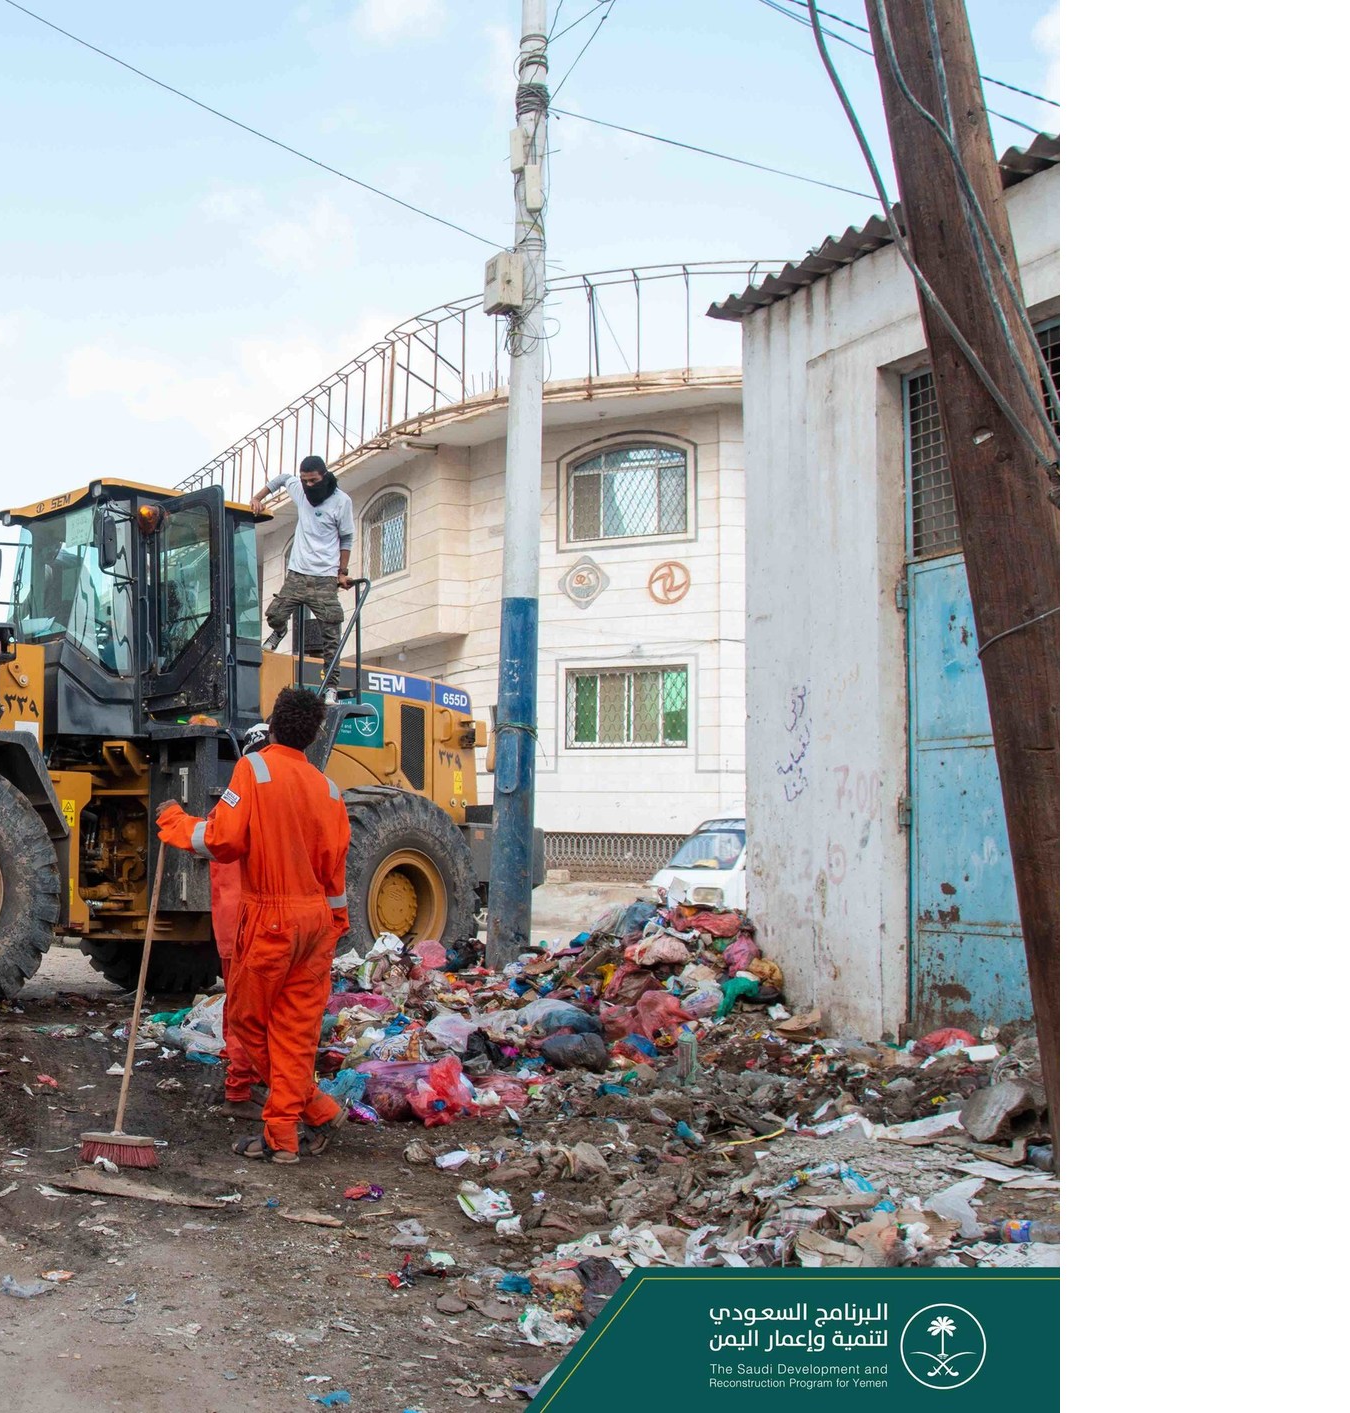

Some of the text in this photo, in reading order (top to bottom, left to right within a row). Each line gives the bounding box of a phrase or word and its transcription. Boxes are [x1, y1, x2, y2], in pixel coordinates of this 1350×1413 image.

[50, 493, 72, 510] SEM
[367, 672, 406, 694] SEM
[3, 692, 40, 718] ٣٣٩
[442, 692, 468, 708] 655D
